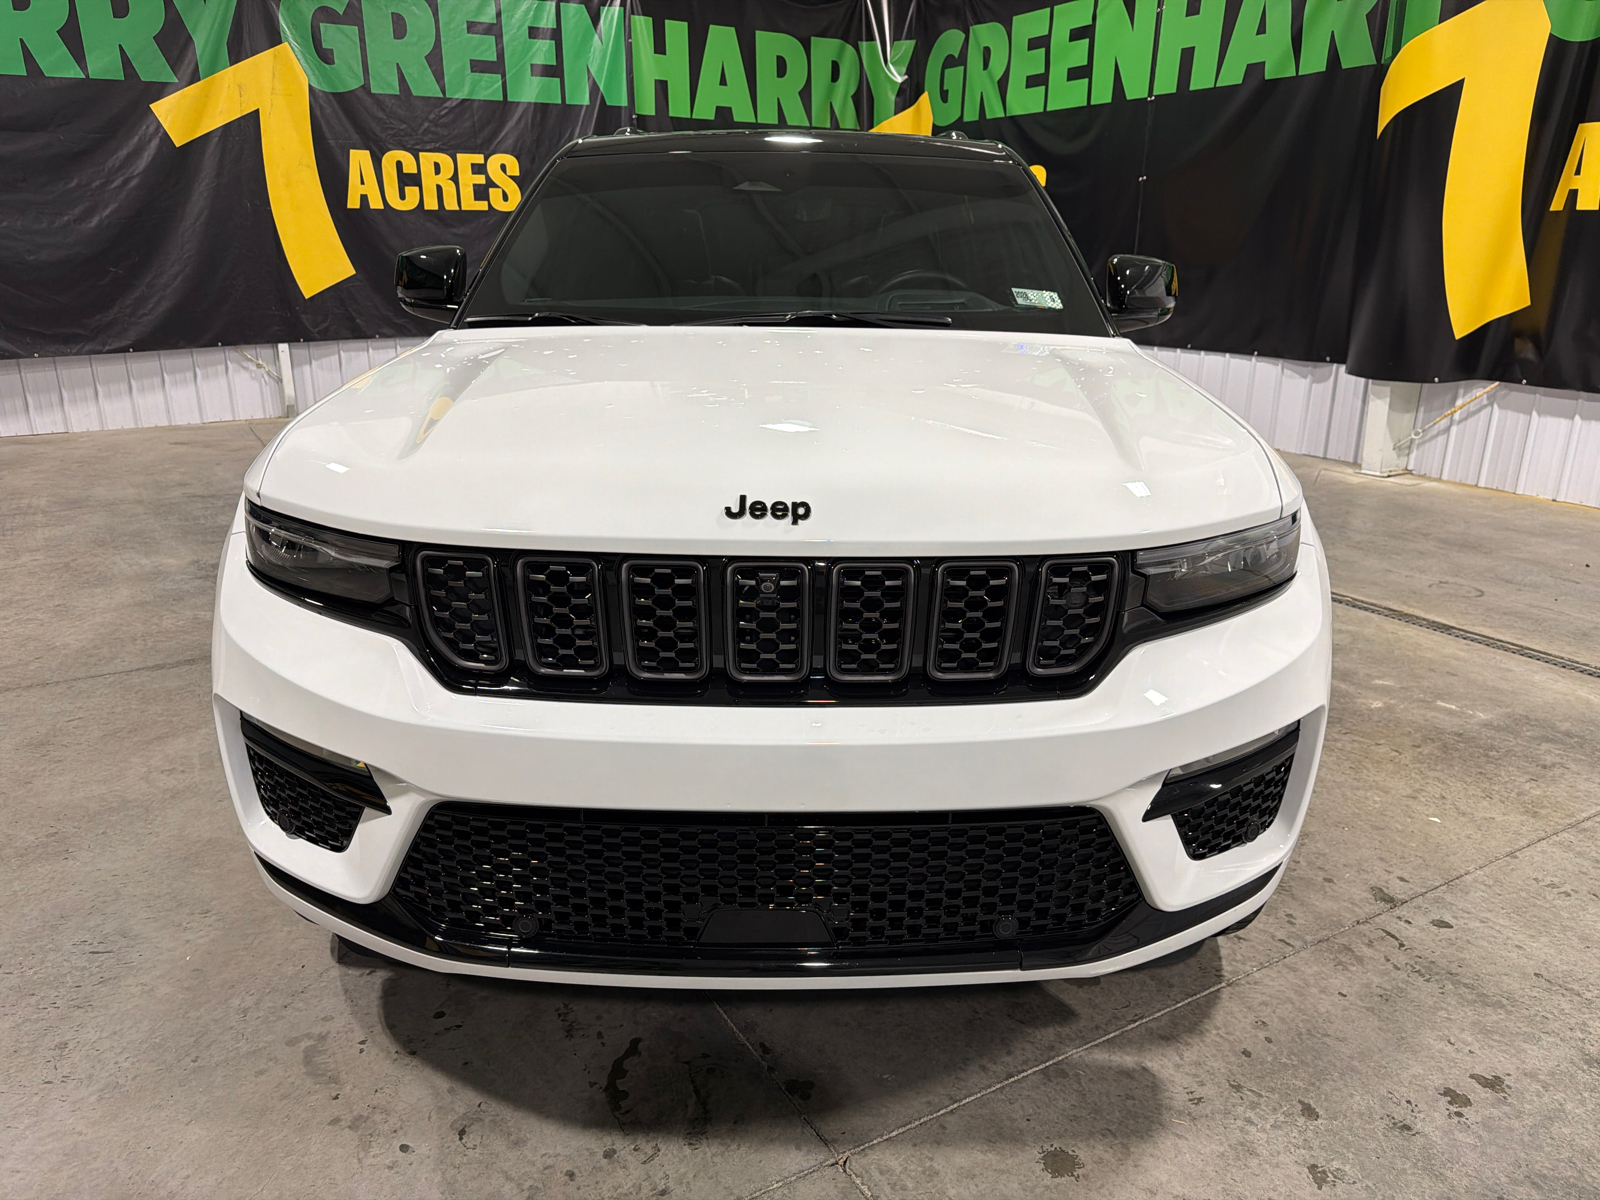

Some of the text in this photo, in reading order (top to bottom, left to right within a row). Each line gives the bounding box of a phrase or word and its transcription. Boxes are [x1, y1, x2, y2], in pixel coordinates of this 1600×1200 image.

[279, 0, 629, 107] GREEN
[630, 0, 1157, 129] HARRY GREEN
[149, 41, 522, 300] 7 ACRES
[1376, 0, 1552, 340] 7
[724, 494, 812, 526] Jeep
